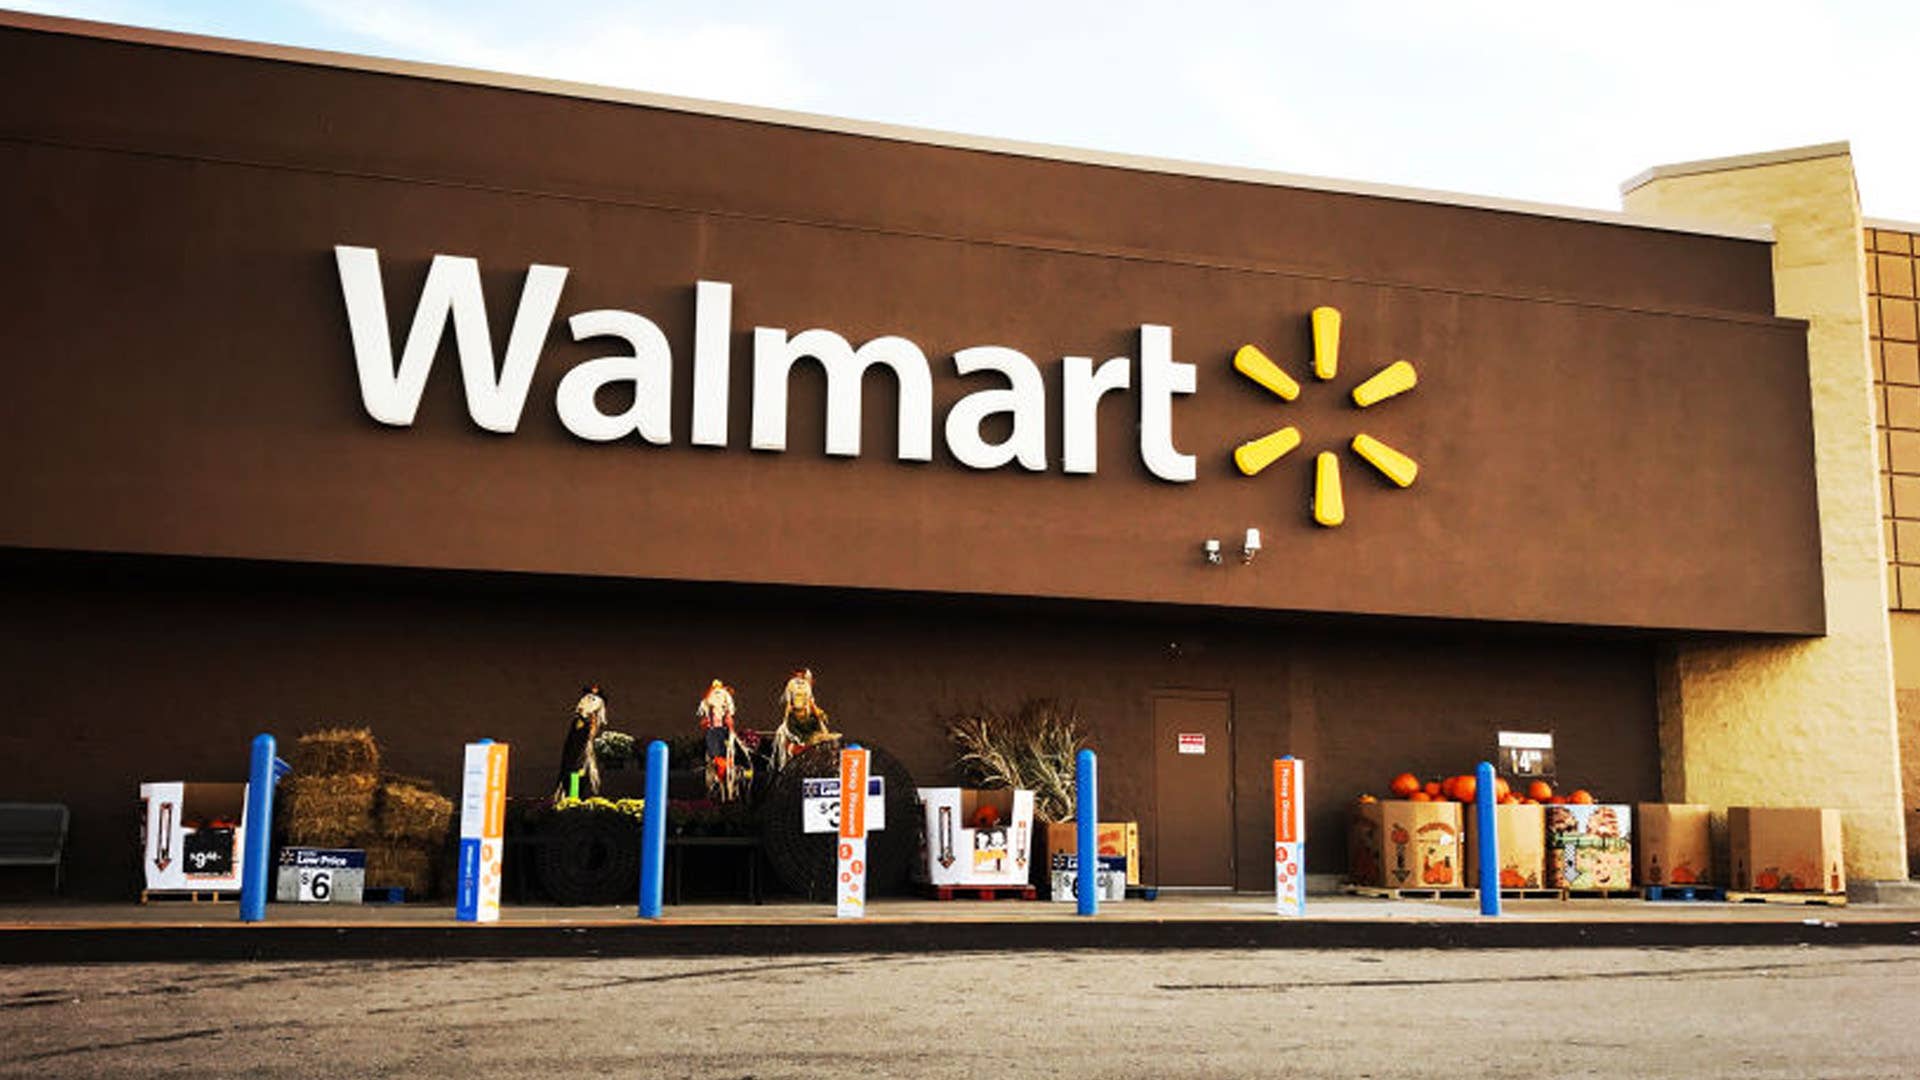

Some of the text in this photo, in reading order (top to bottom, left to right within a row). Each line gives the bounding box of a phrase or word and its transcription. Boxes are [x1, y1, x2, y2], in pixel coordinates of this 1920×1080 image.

[334, 245, 1198, 482] Walmart
[298, 855, 347, 867] Low Price
